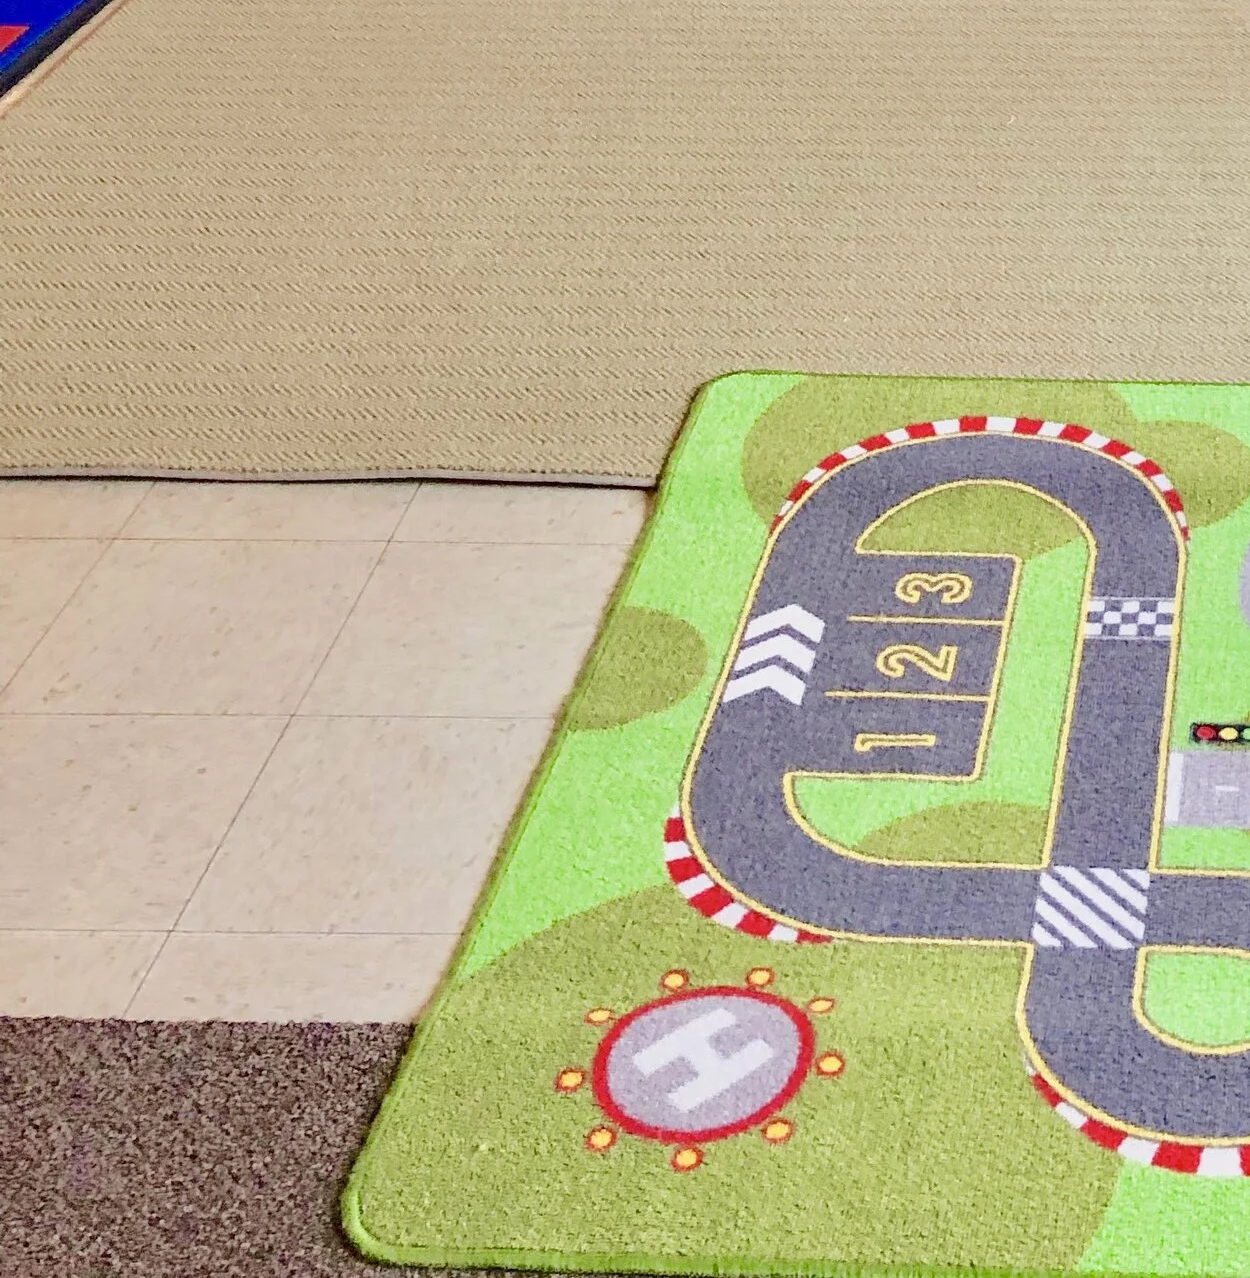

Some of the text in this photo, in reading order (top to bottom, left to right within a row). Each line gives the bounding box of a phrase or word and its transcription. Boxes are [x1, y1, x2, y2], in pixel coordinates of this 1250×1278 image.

[895, 572, 973, 604] 3
[876, 644, 959, 682] 2
[854, 733, 937, 753] 1
[632, 1008, 775, 1113] H
